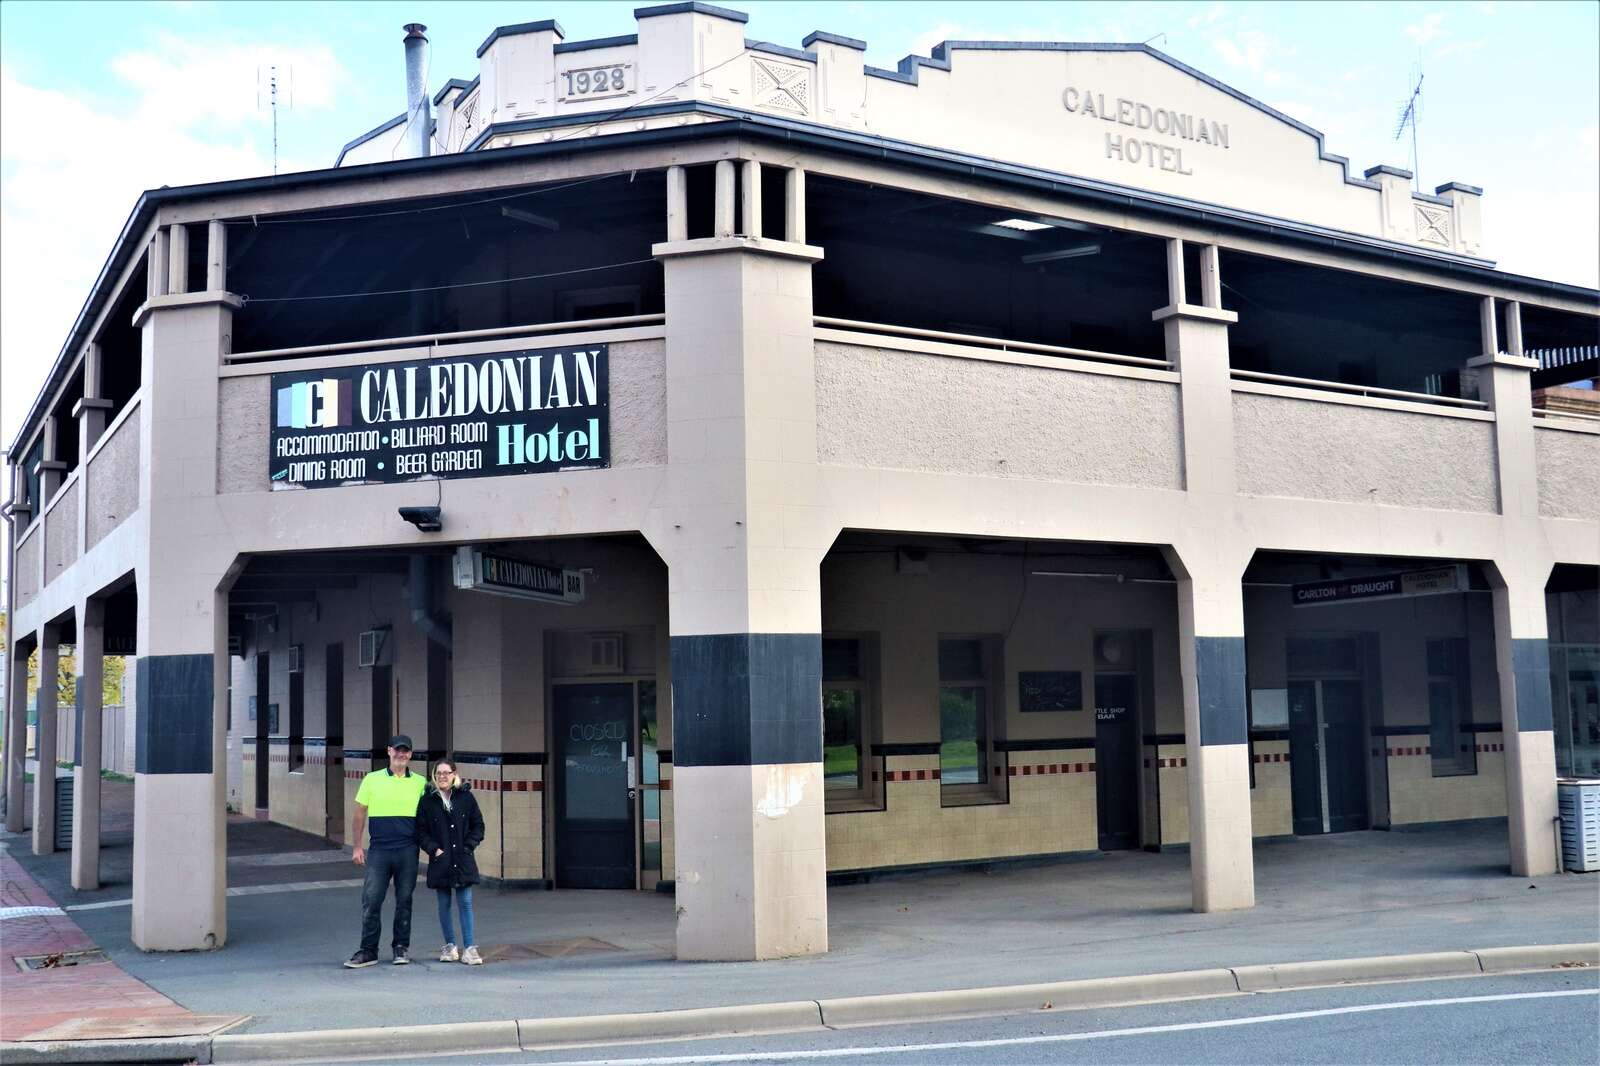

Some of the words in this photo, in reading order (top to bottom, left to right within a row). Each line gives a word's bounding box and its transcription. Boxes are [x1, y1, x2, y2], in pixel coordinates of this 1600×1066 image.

[566, 68, 625, 96] 1928
[1062, 86, 1230, 149] CALEDONIAN
[1104, 132, 1193, 176] HOTEL
[360, 350, 601, 424] CALEDONIAN
[276, 430, 380, 457] ACCOMMODATION
[391, 425, 446, 449] BILLIARD
[450, 421, 488, 443] ROOM
[496, 418, 602, 467] Hotel
[288, 461, 326, 483] DINING
[330, 458, 366, 480] ROOM
[396, 453, 428, 475] BEER
[431, 449, 483, 472] GARDEN
[567, 575, 581, 593] BAR
[1297, 587, 1337, 600] CARLTON
[1351, 580, 1395, 594] DRAUGHT
